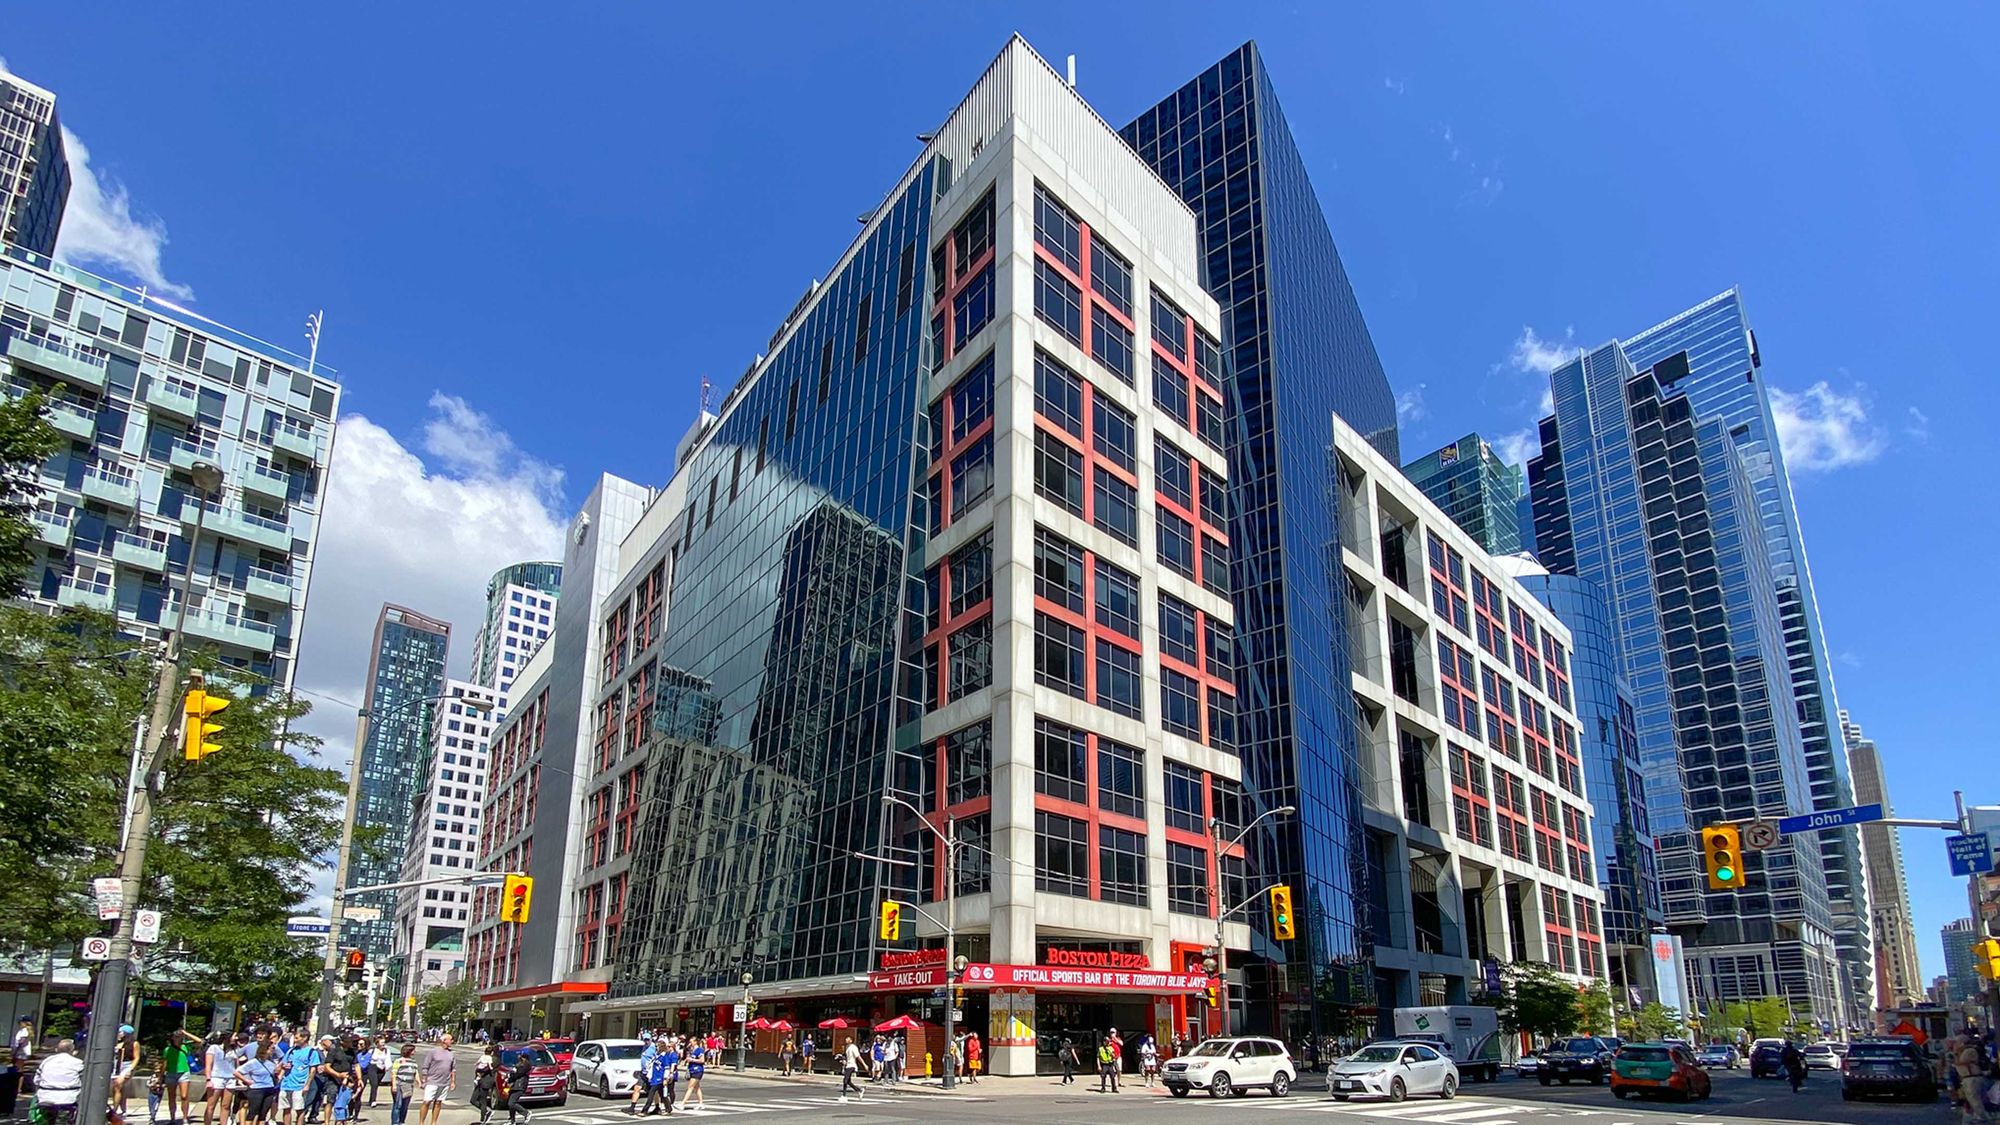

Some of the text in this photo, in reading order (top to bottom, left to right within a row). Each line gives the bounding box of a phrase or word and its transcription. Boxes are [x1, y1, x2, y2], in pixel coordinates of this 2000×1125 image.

[1808, 813, 1842, 828] John
[1949, 837, 1985, 847] Hockey
[1951, 845, 1972, 854] Hall
[1956, 852, 1984, 861] Fame
[1048, 947, 1151, 968] BOSTON PIZZA
[893, 971, 933, 986] TAKE-OUT
[1013, 969, 1207, 988] OFFICIAL SPORTS BAR OF THE TORONTO BLUE JAYS
[735, 1011, 746, 1020] 30
